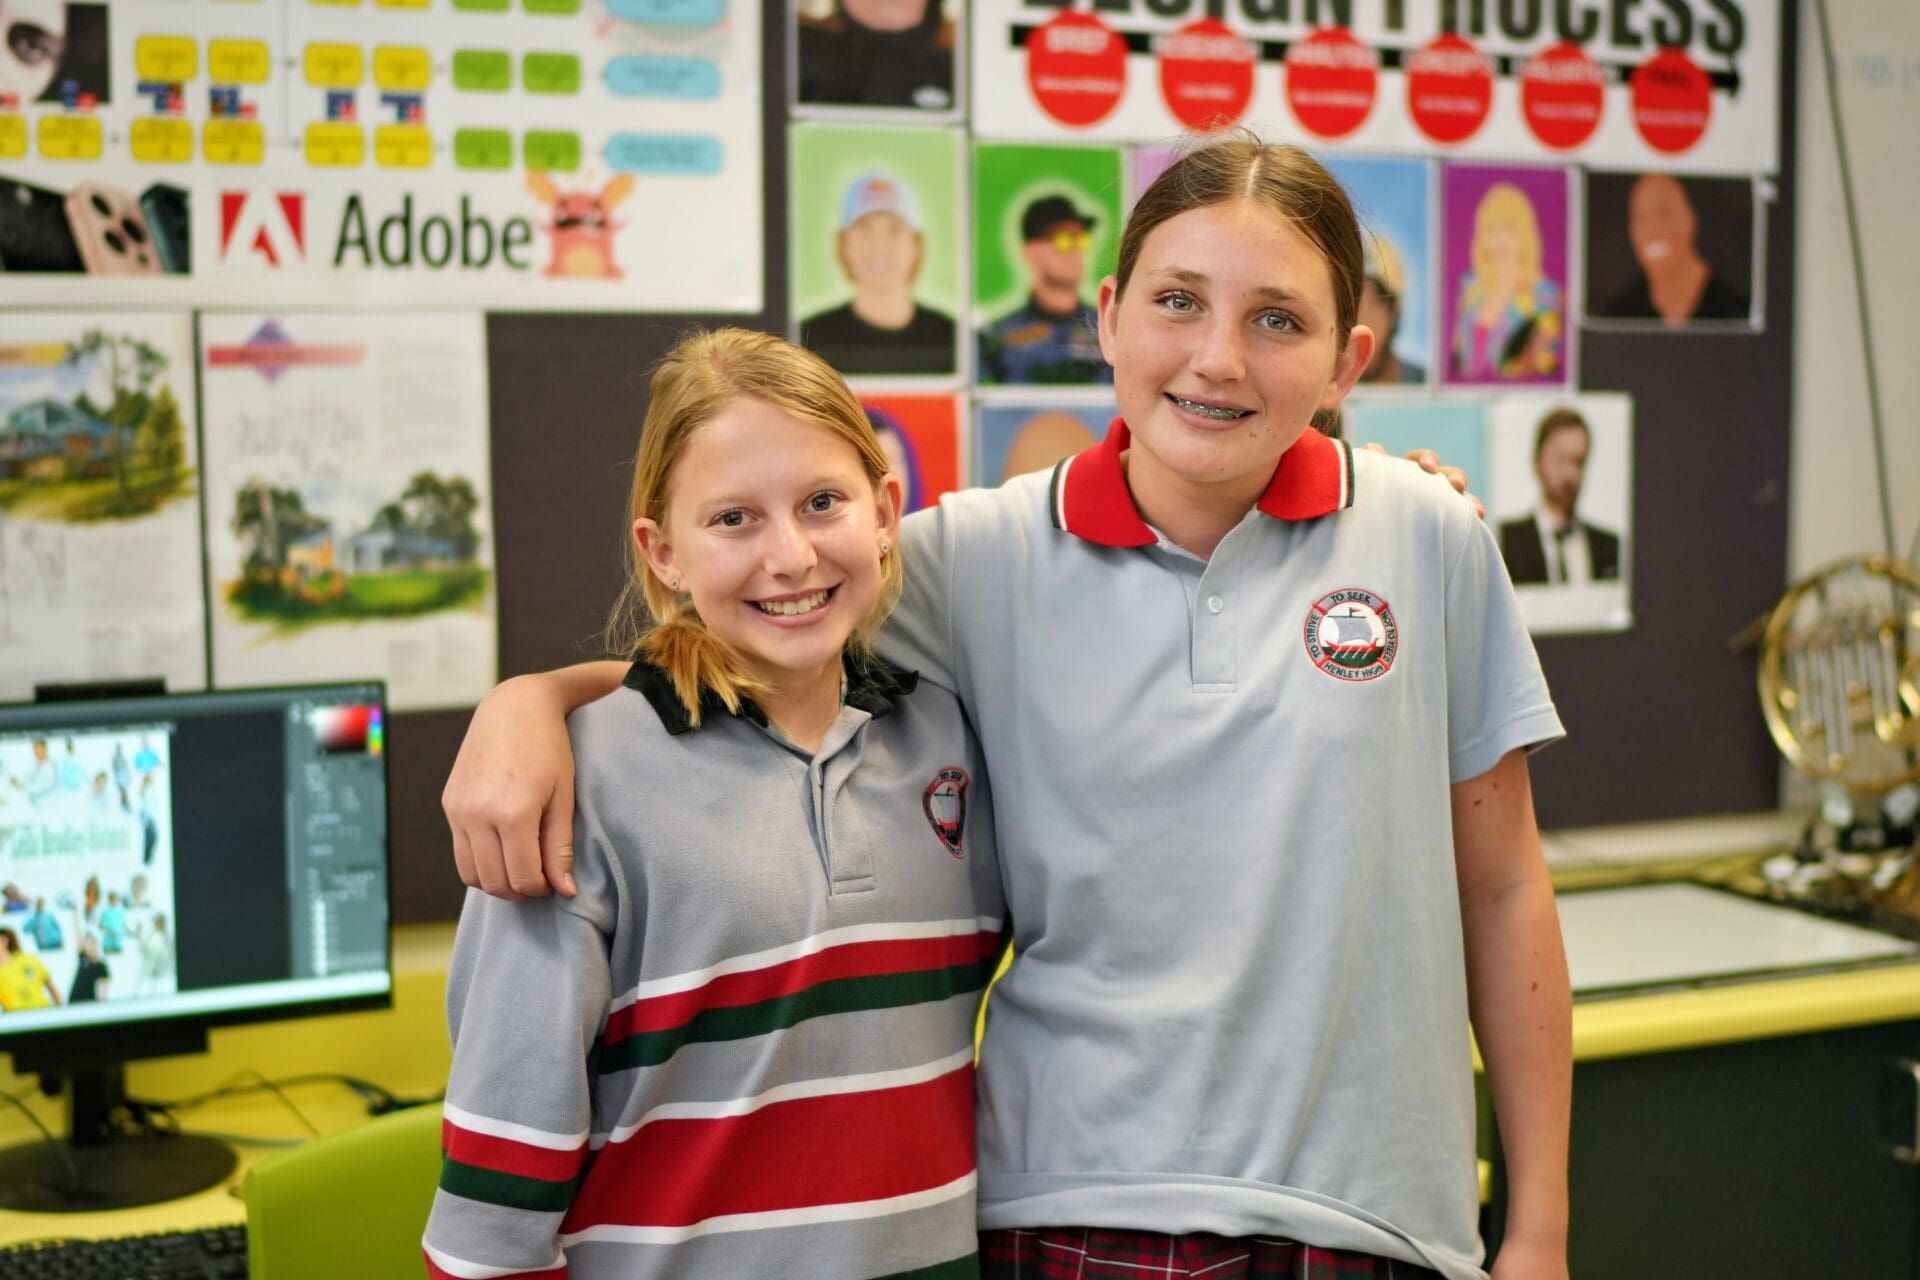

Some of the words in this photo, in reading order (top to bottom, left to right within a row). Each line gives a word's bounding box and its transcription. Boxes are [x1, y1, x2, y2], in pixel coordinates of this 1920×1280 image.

[332, 191, 534, 269] Adobe
[1330, 593, 1345, 604] TO
[1347, 591, 1371, 604] SEEK
[1310, 645, 1321, 658] TO
[1324, 662, 1360, 678] HENLEY
[1361, 664, 1384, 677] HIGH
